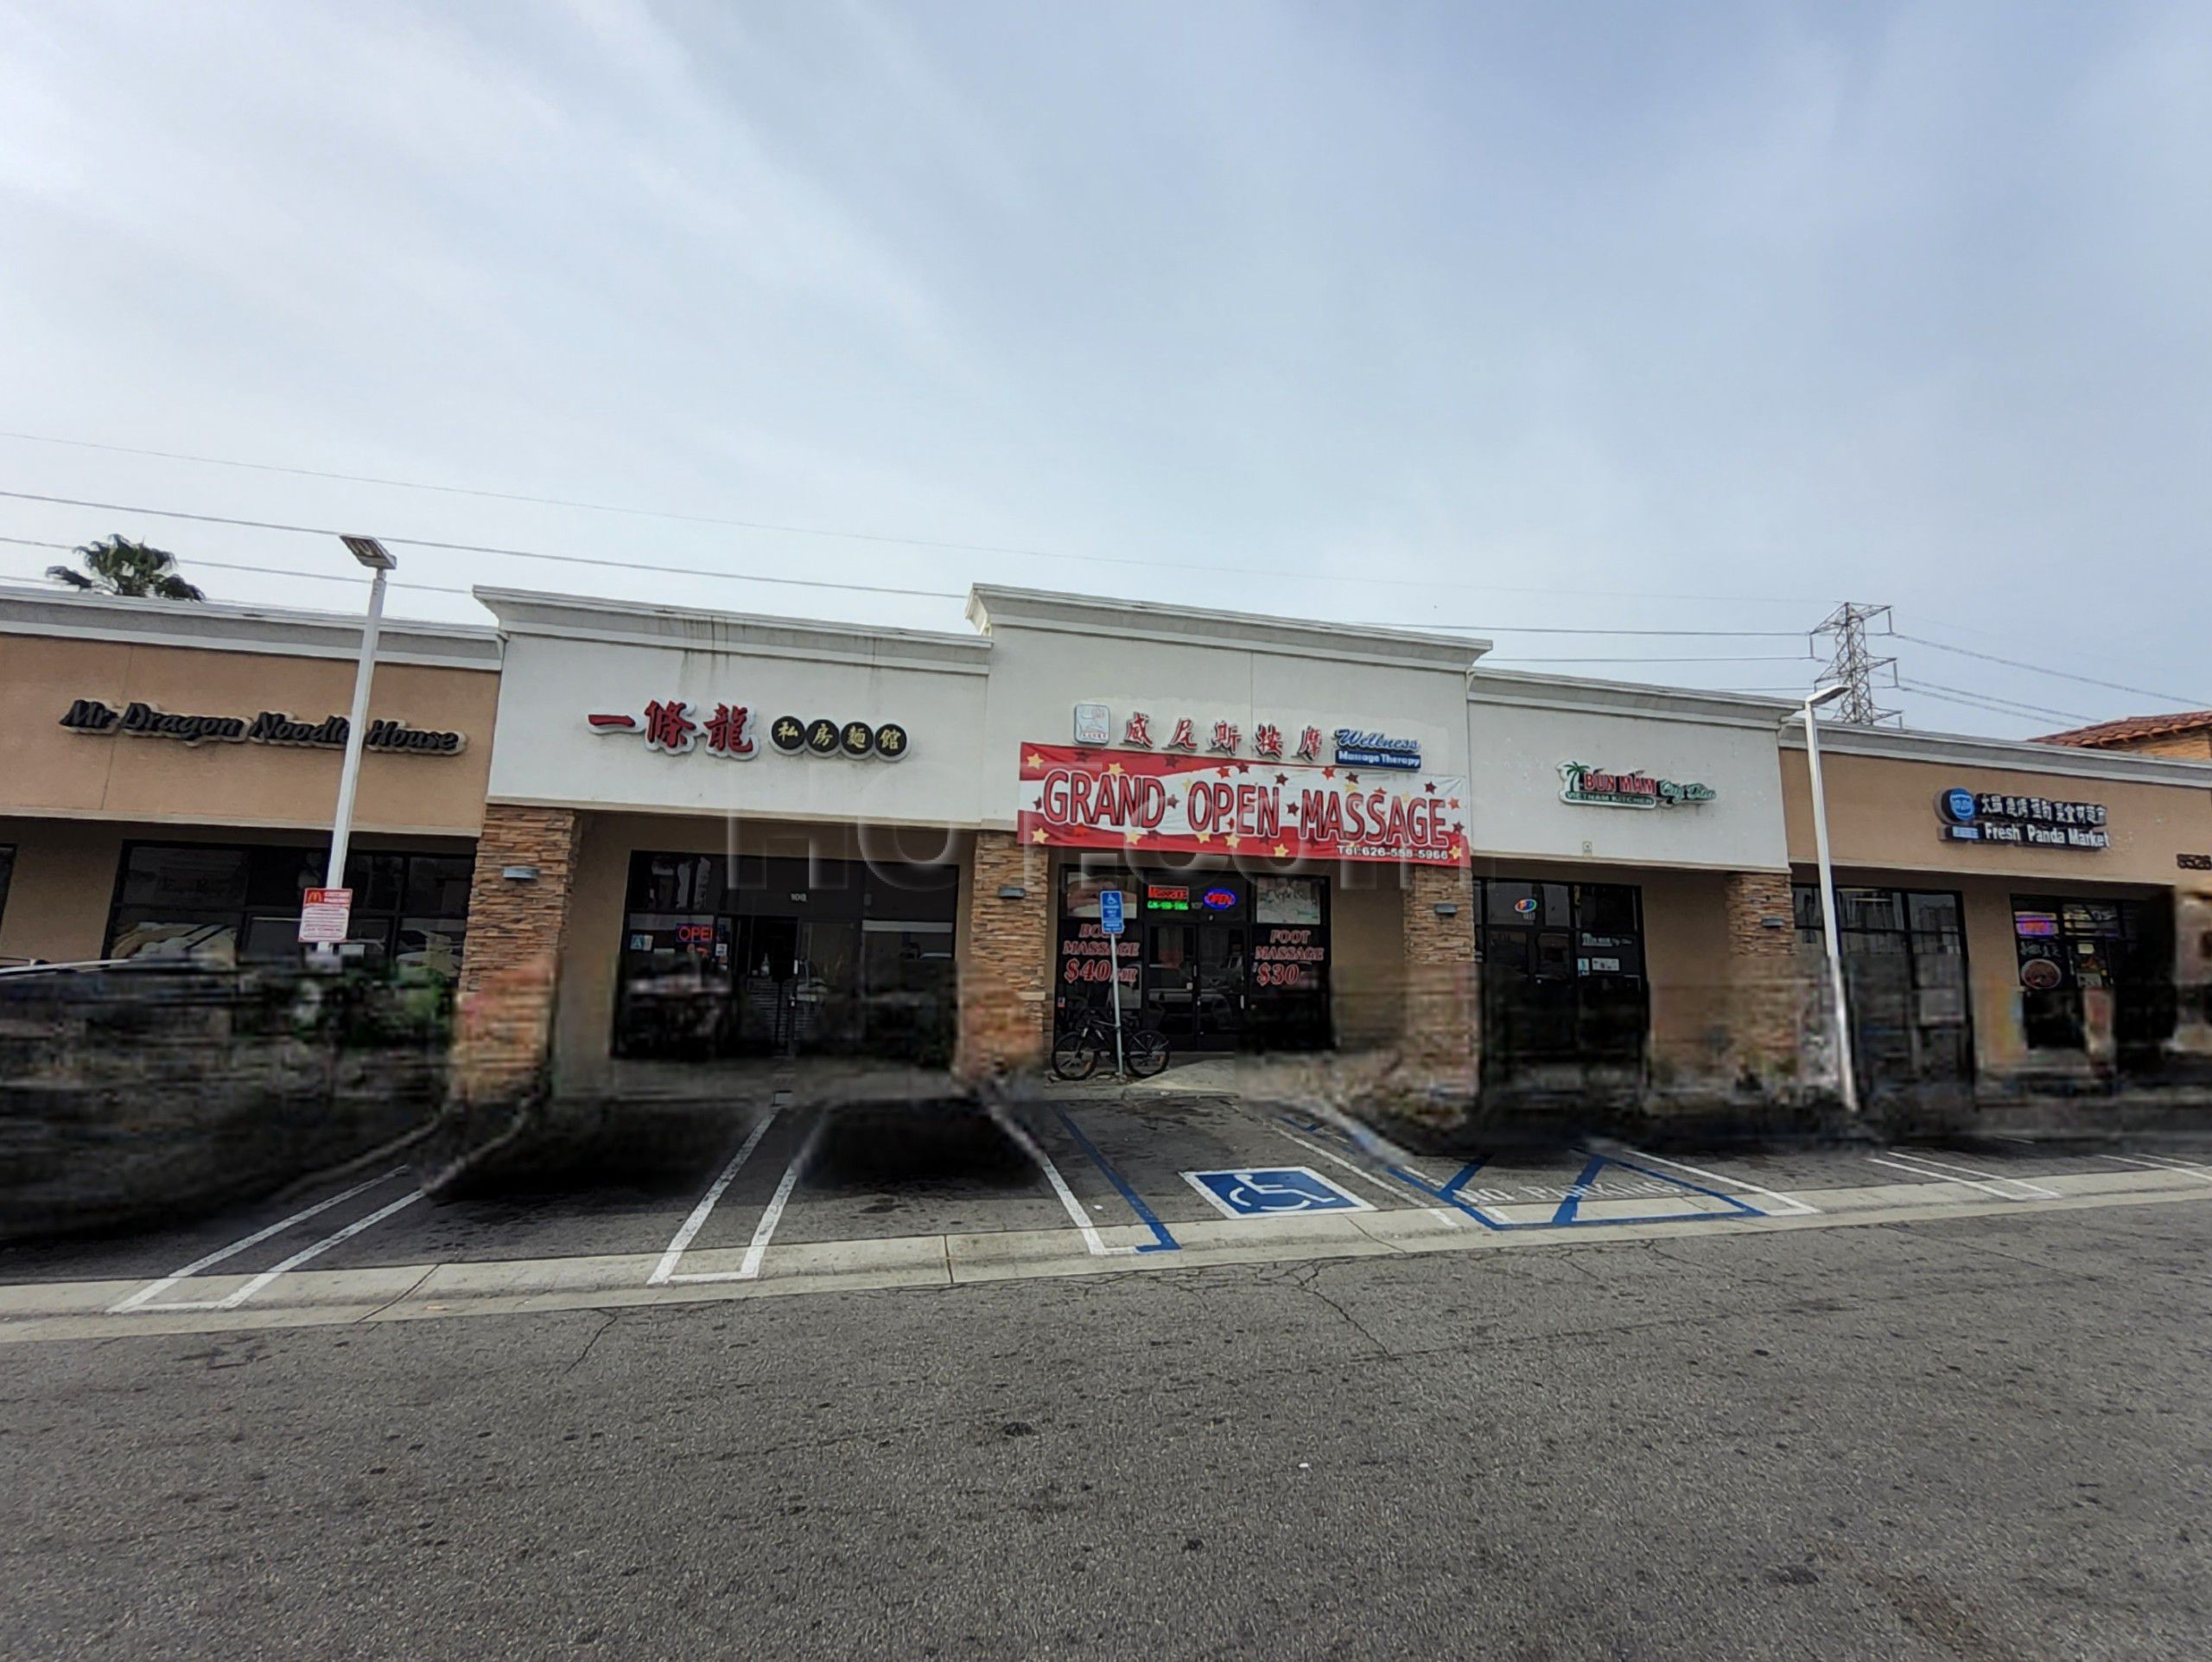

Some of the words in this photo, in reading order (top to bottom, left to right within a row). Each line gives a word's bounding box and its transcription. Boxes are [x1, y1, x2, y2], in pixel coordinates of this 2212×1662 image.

[120, 702, 245, 742] Dragon
[365, 719, 460, 750] House
[588, 699, 753, 753] 一條龍
[1124, 711, 1324, 761] 威尼斯按摩
[1337, 728, 1419, 750] Wellness
[1338, 750, 1380, 764] Massage
[1380, 753, 1420, 767] Therapy
[1043, 768, 1166, 829] GRAND
[1187, 780, 1280, 837] OPEN
[1300, 788, 1449, 847] MASSAGE
[1566, 792, 1610, 802] VIETNAM
[1611, 795, 1654, 805] KITCHEN
[1984, 821, 2021, 841] Fresh
[2026, 824, 2066, 844] Panda
[2068, 827, 2110, 848] Market
[1269, 929, 1312, 944] FOOT
[1255, 946, 1325, 961] MASSAGE
[1256, 962, 1300, 986] $30
